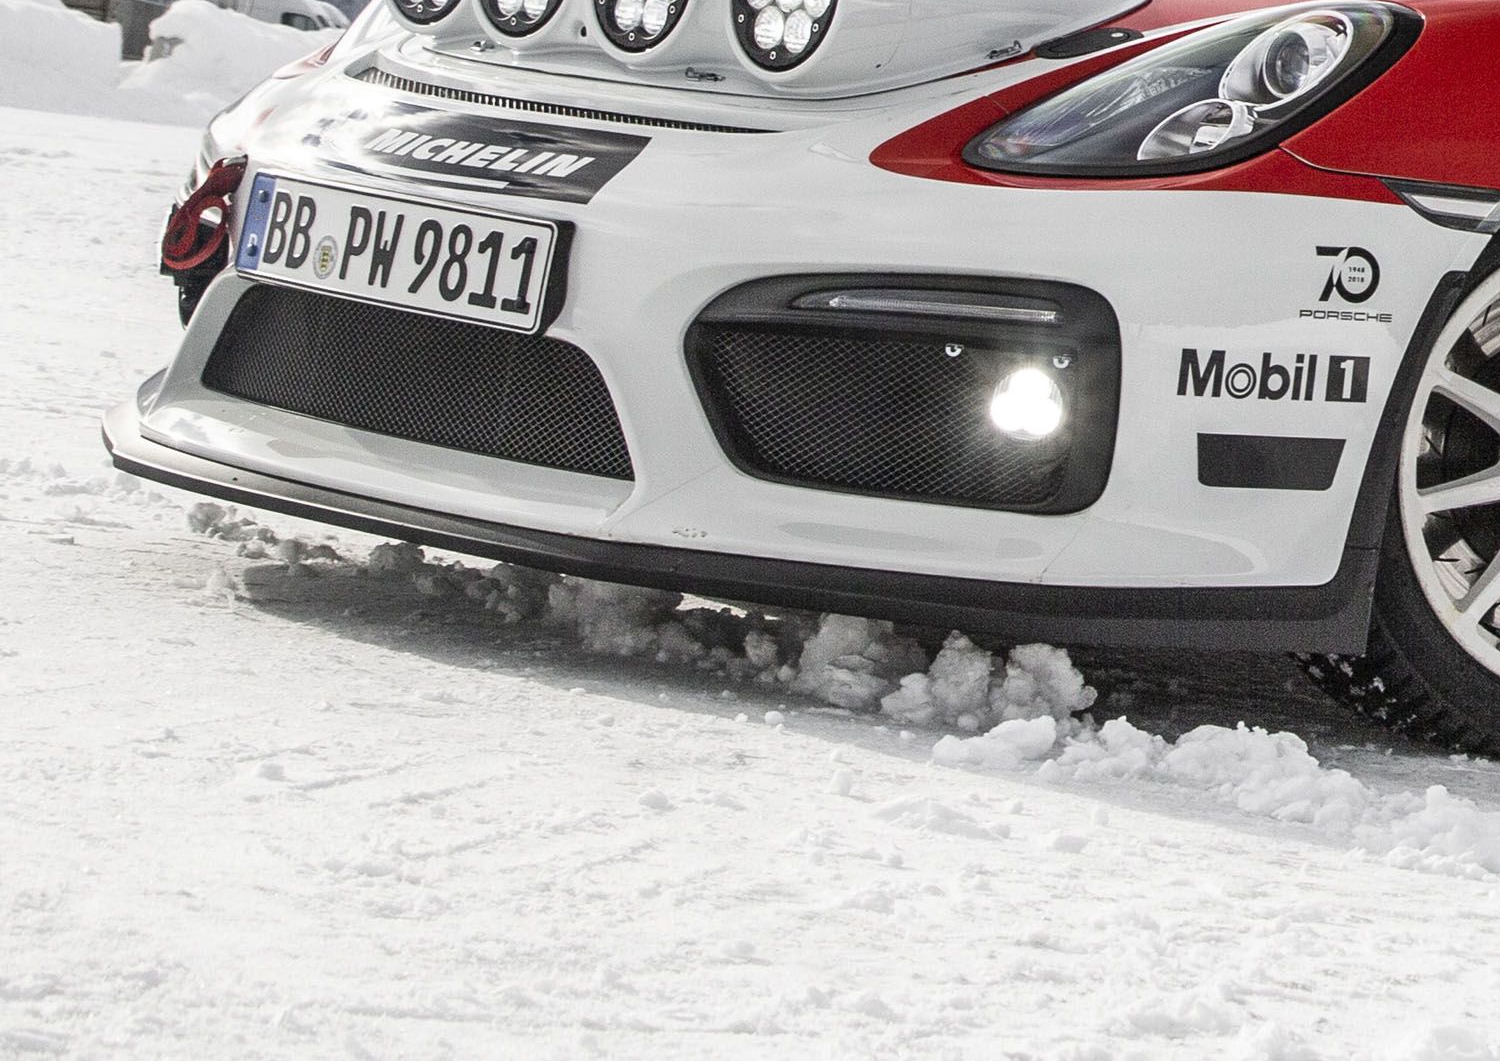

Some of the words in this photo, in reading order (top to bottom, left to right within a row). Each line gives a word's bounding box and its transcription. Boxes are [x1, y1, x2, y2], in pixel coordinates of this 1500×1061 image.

[364, 128, 596, 178] MICHELIN
[262, 191, 316, 269] BB
[339, 205, 404, 288] PW
[408, 219, 539, 315] 9811
[1315, 246, 1380, 303] 70
[1348, 266, 1366, 274] 1948
[1299, 309, 1393, 323] PORSCHE
[1177, 348, 1318, 401] Mobil
